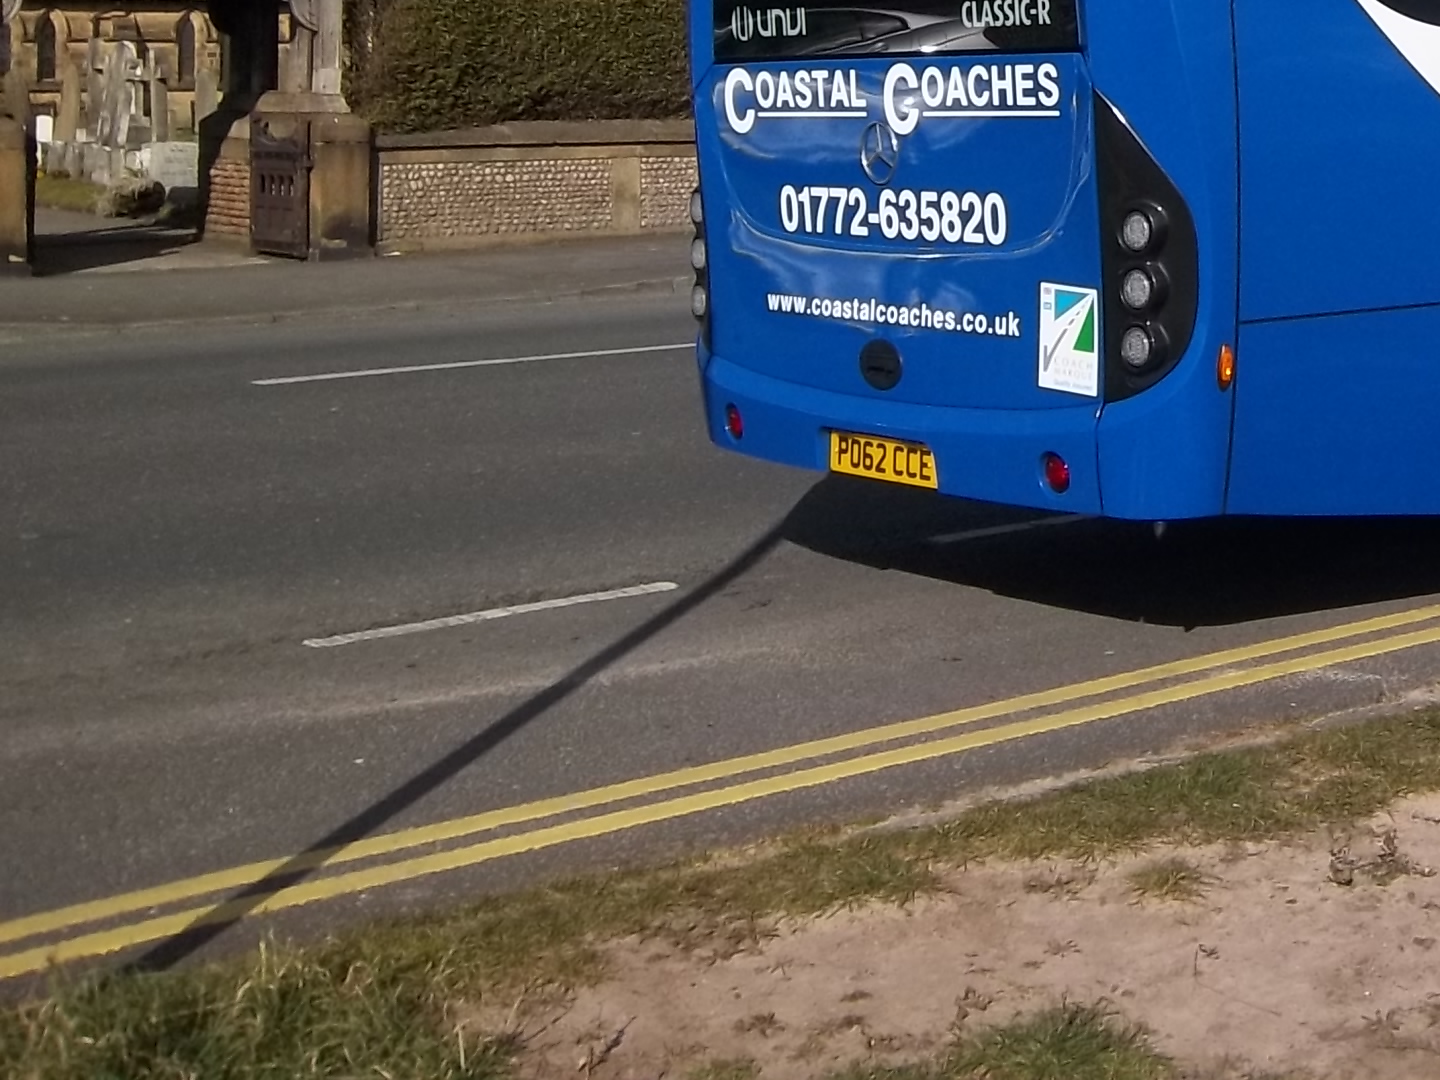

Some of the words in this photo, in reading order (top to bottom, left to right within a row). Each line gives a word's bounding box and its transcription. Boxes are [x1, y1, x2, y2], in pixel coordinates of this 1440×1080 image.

[724, 67, 867, 134] COASTAL
[883, 62, 1060, 135] COACHES
[780, 185, 1007, 245] 01772-635820
[767, 293, 1020, 337] www.coastalcoaches.co.uk
[838, 435, 887, 474] PO62
[893, 445, 932, 482] CCE
